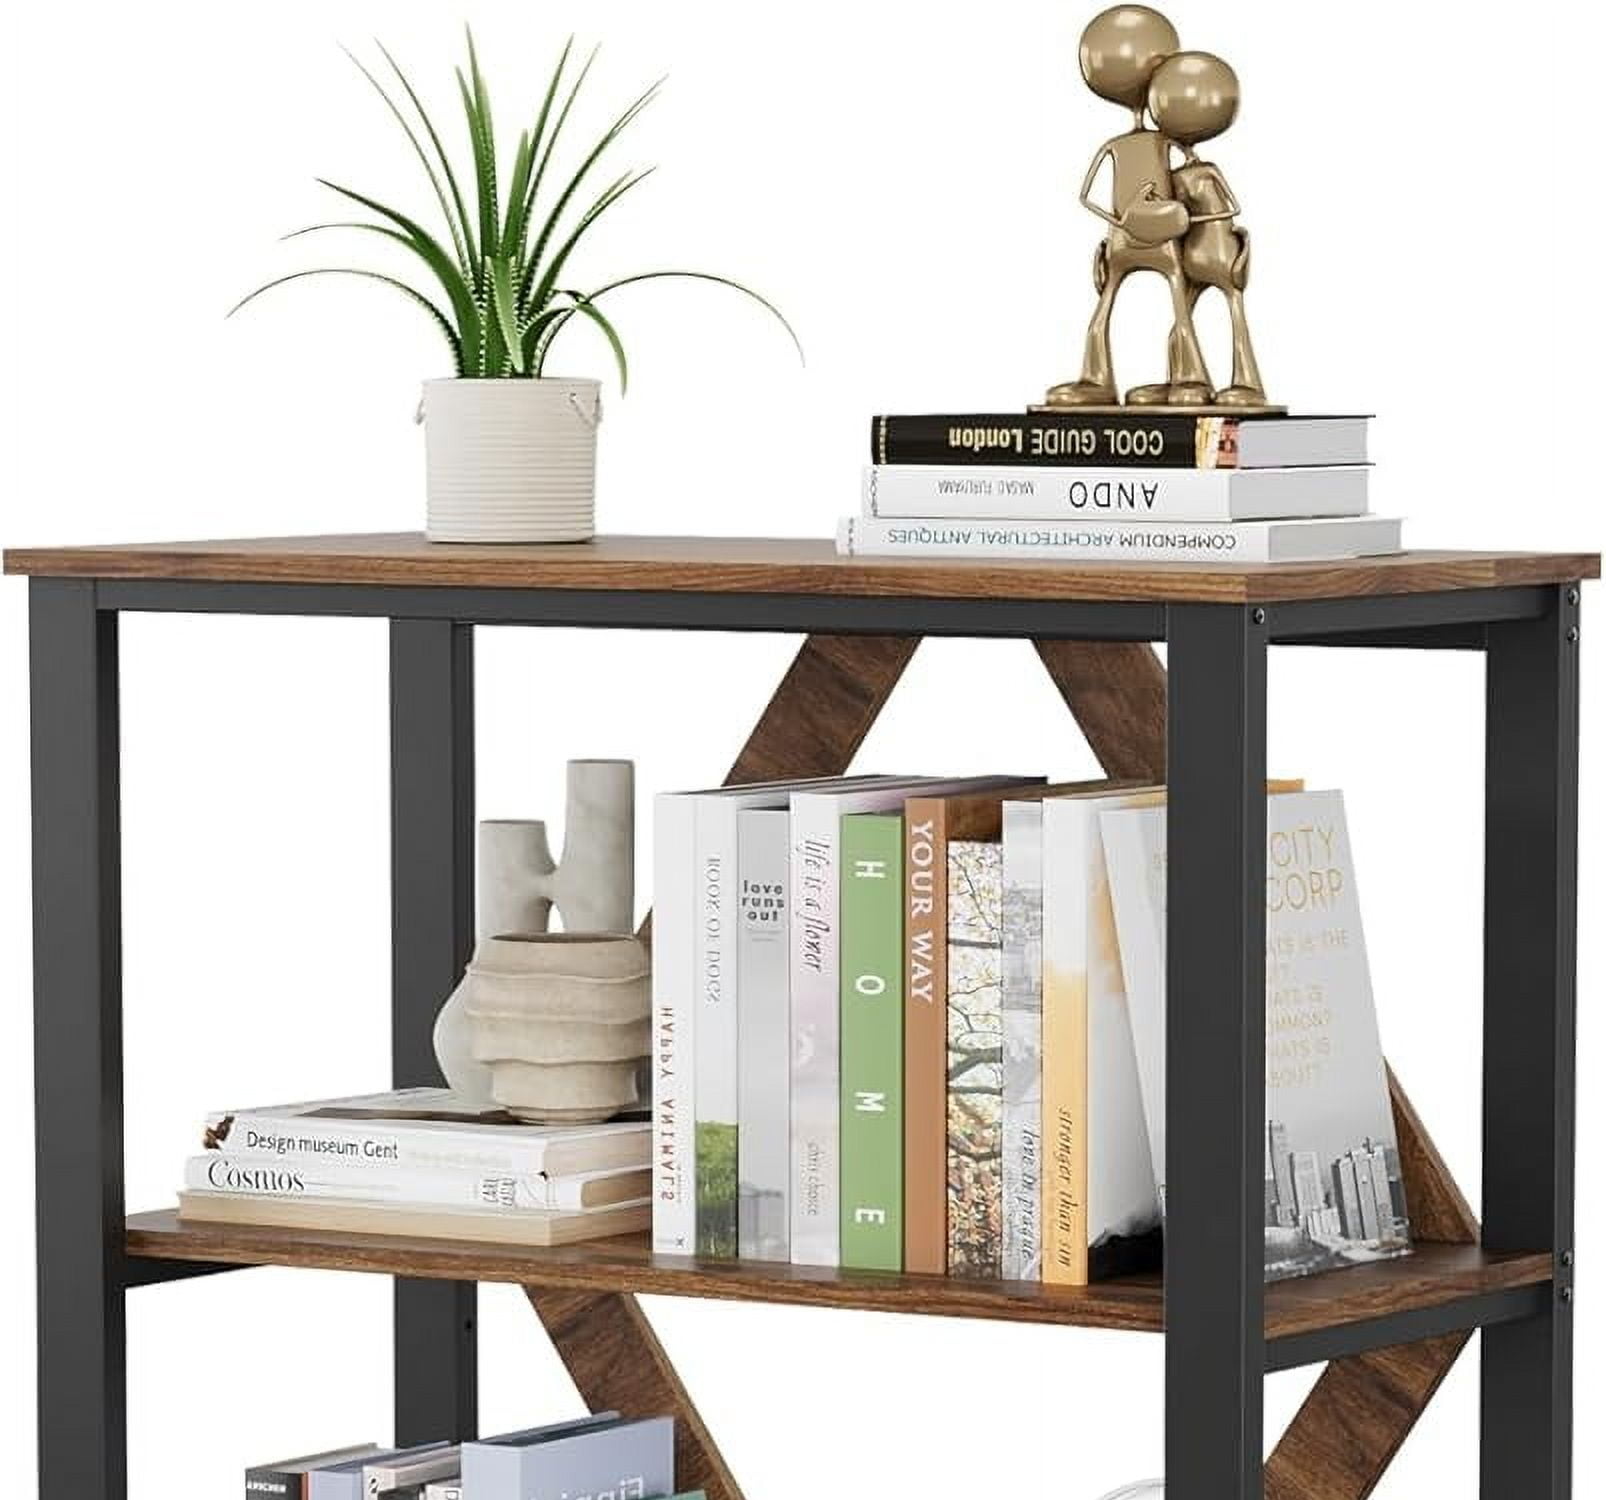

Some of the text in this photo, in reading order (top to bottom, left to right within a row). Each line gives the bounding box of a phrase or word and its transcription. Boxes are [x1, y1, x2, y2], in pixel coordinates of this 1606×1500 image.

[948, 425, 1165, 457] COOL GUIDE London
[1068, 480, 1160, 510] ANDO
[887, 525, 1238, 550] COMPENDIUM ARCHITECTURAL ANTIQUES
[1270, 826, 1338, 868] CITY
[741, 896, 785, 909] runs
[743, 879, 784, 896] love
[747, 910, 779, 922] out
[796, 840, 831, 973] life is a flower
[910, 819, 935, 1003] YOUR WAY
[246, 1130, 399, 1160] Design museum Gent
[1021, 1128, 1041, 1166] love
[207, 1158, 306, 1193] Cosmos
[1054, 1105, 1079, 1269] stronger than sin
[1016, 1196, 1037, 1260] prague
